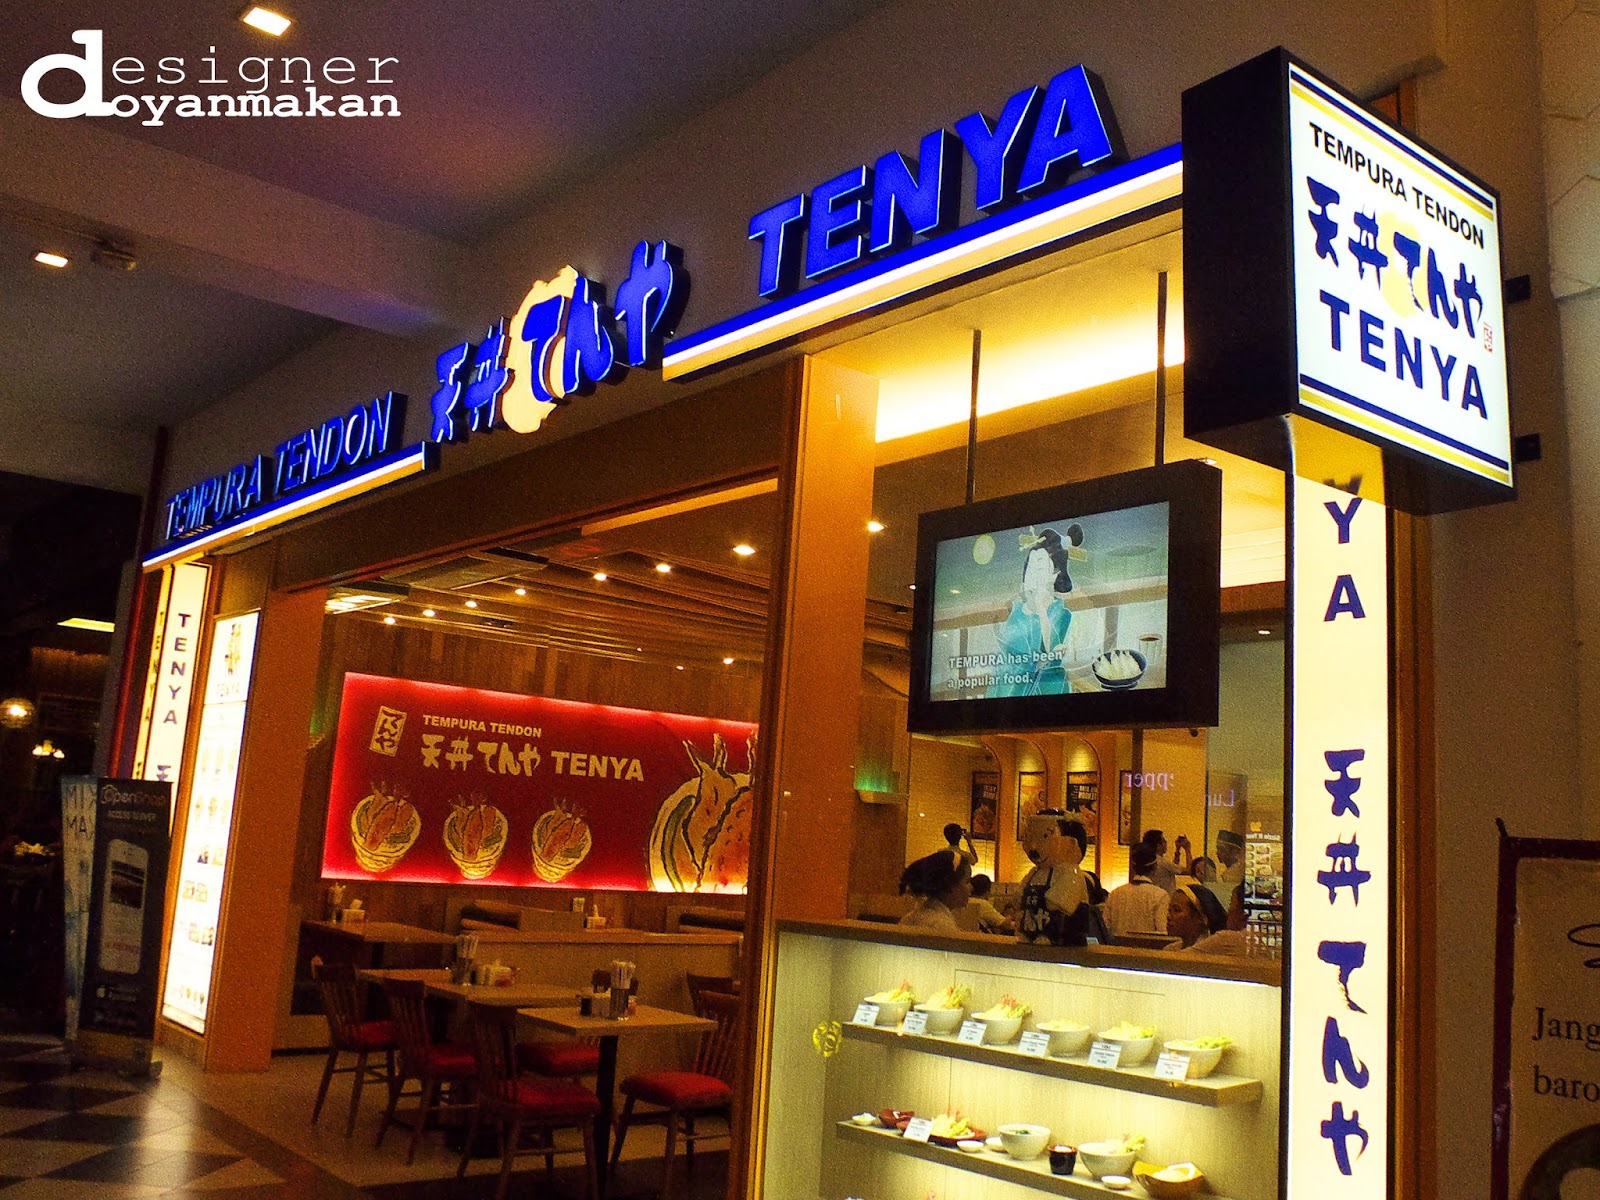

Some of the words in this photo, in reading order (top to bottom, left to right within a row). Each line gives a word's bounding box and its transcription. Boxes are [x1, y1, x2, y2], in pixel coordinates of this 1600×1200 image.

[748, 63, 1114, 297] TENYA
[1308, 122, 1409, 201] TEMPURA
[1412, 186, 1485, 250] TENDON
[1319, 289, 1489, 420] TENYA
[166, 454, 262, 541] TEMPURA
[273, 390, 393, 496] TENDON
[163, 612, 192, 725] TENYA
[948, 653, 1005, 669] TEMPURA
[1007, 652, 1030, 665] has
[1032, 649, 1064, 662] been
[959, 674, 1001, 690] popular
[422, 714, 487, 732] TEMPURA
[490, 722, 543, 738] TENDON
[550, 750, 646, 782] TENYA
